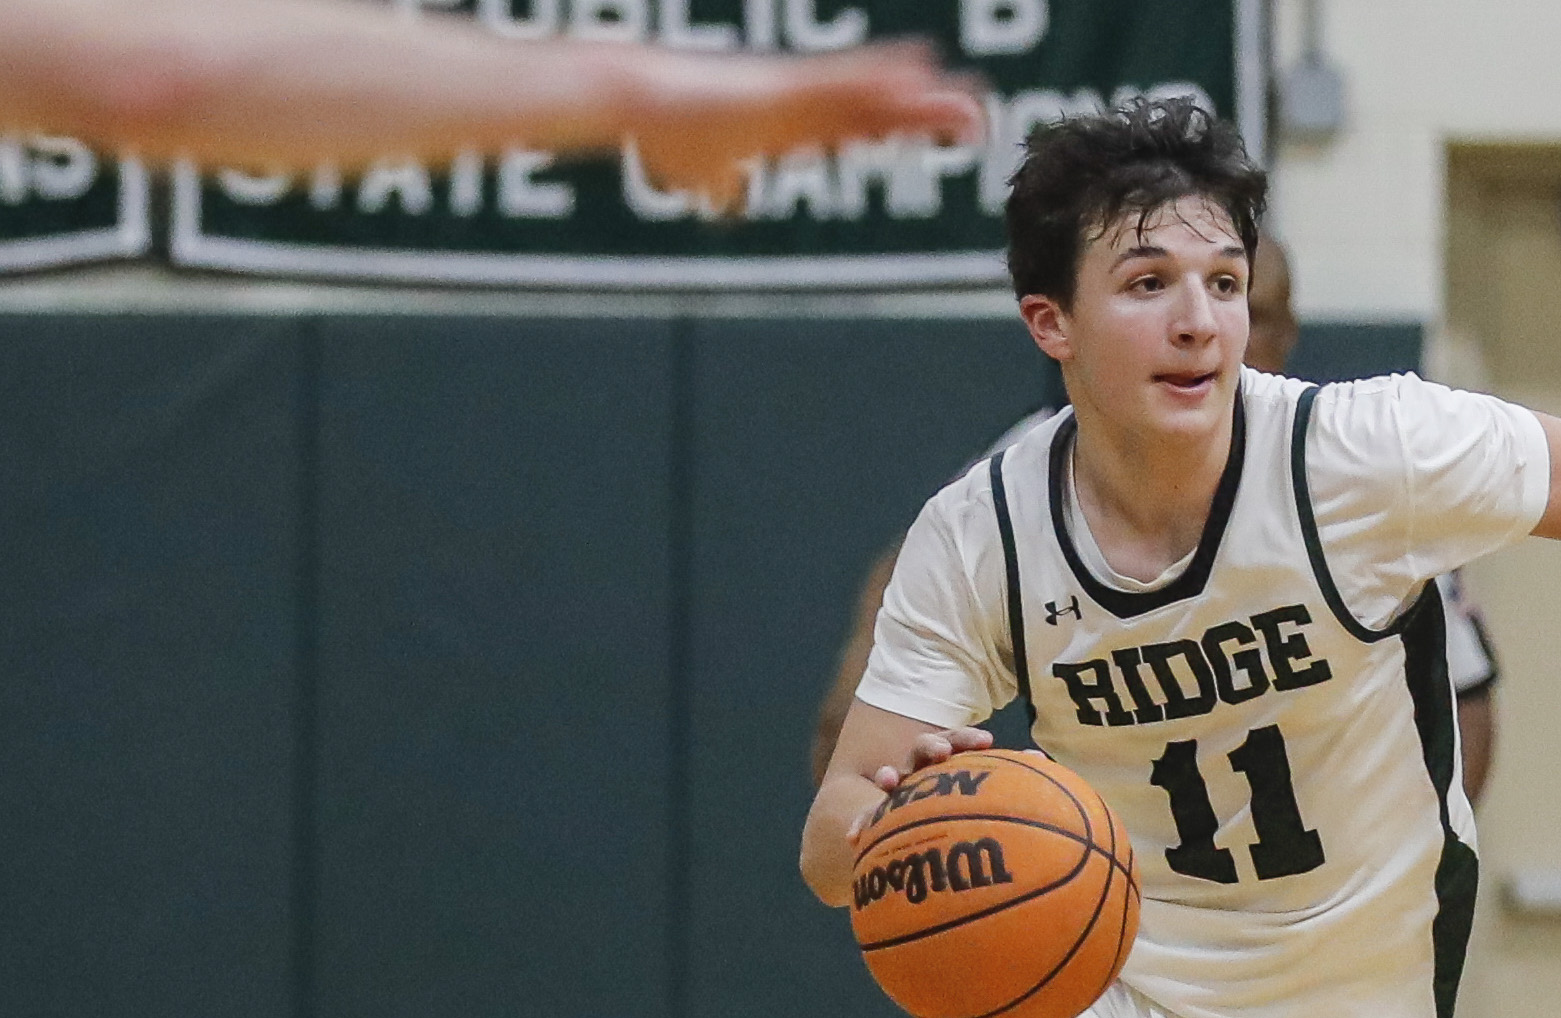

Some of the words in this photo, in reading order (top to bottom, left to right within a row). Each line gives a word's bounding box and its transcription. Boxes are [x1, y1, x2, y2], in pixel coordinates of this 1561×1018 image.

[392, 0, 869, 51] UBLIC
[1052, 602, 1333, 727] RIDGE
[1149, 724, 1326, 885] 11
[852, 837, 1014, 911] Wilson
